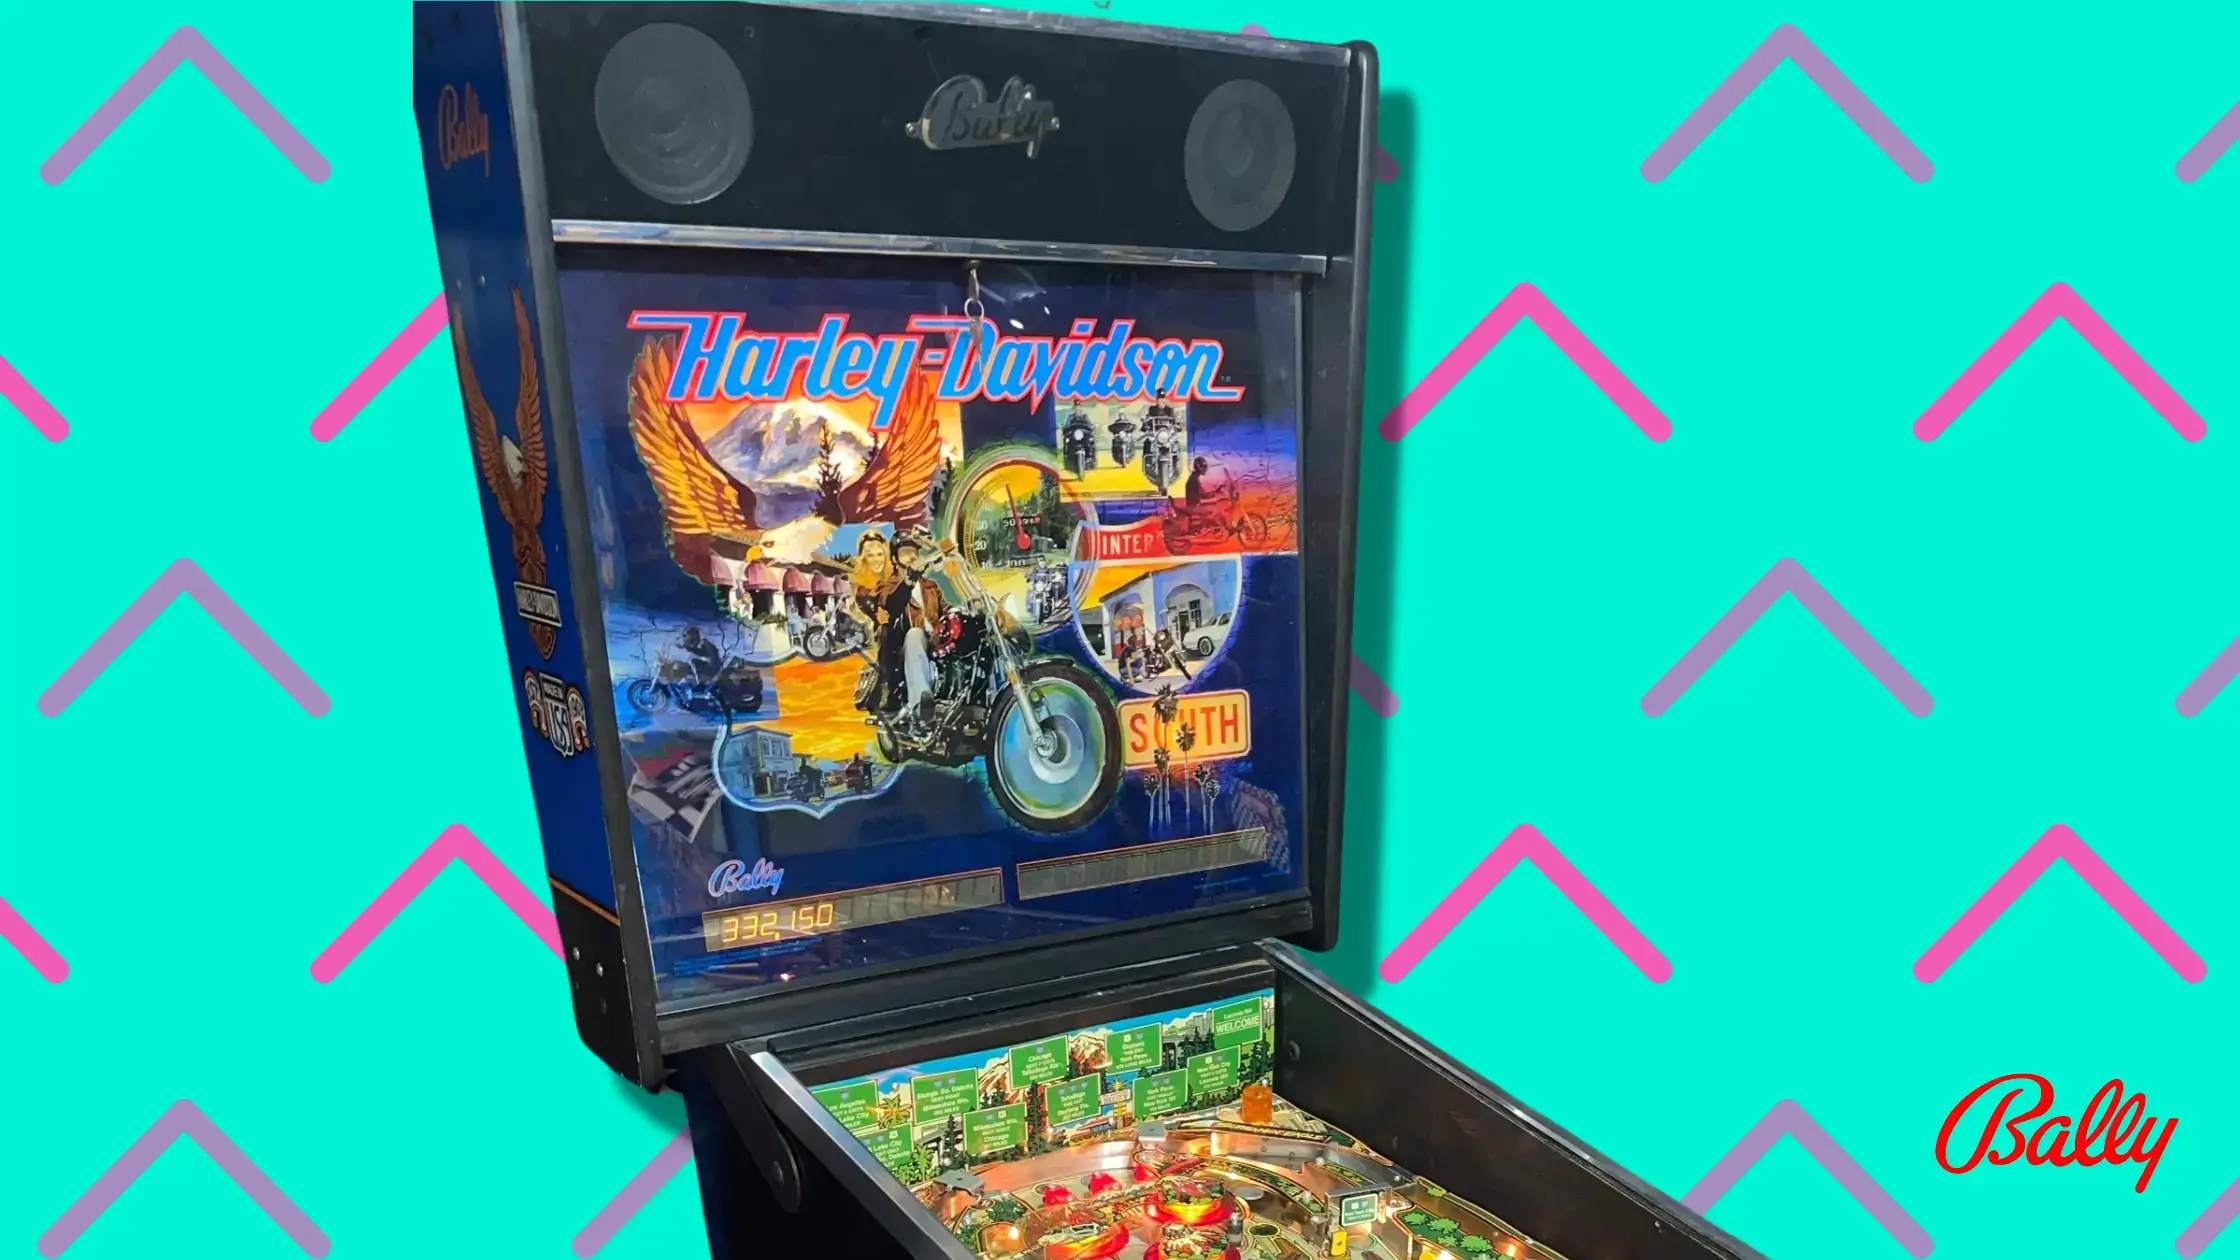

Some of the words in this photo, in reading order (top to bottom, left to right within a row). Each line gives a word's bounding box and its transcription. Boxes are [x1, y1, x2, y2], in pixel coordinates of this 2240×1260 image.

[922, 74, 1053, 159] Bally
[438, 81, 490, 177] Bally
[628, 310, 1246, 433] Harley-Davidson
[974, 540, 987, 551] 20
[1103, 533, 1154, 556] INTER
[545, 700, 573, 754] USA
[708, 857, 785, 897] Bally
[721, 903, 834, 941] 332,150
[1216, 1015, 1259, 1033] WELCOME
[1028, 1051, 1051, 1062] Chicago
[856, 1111, 869, 1119] City
[889, 1139, 902, 1148] City
[984, 1132, 1009, 1143] Chicago
